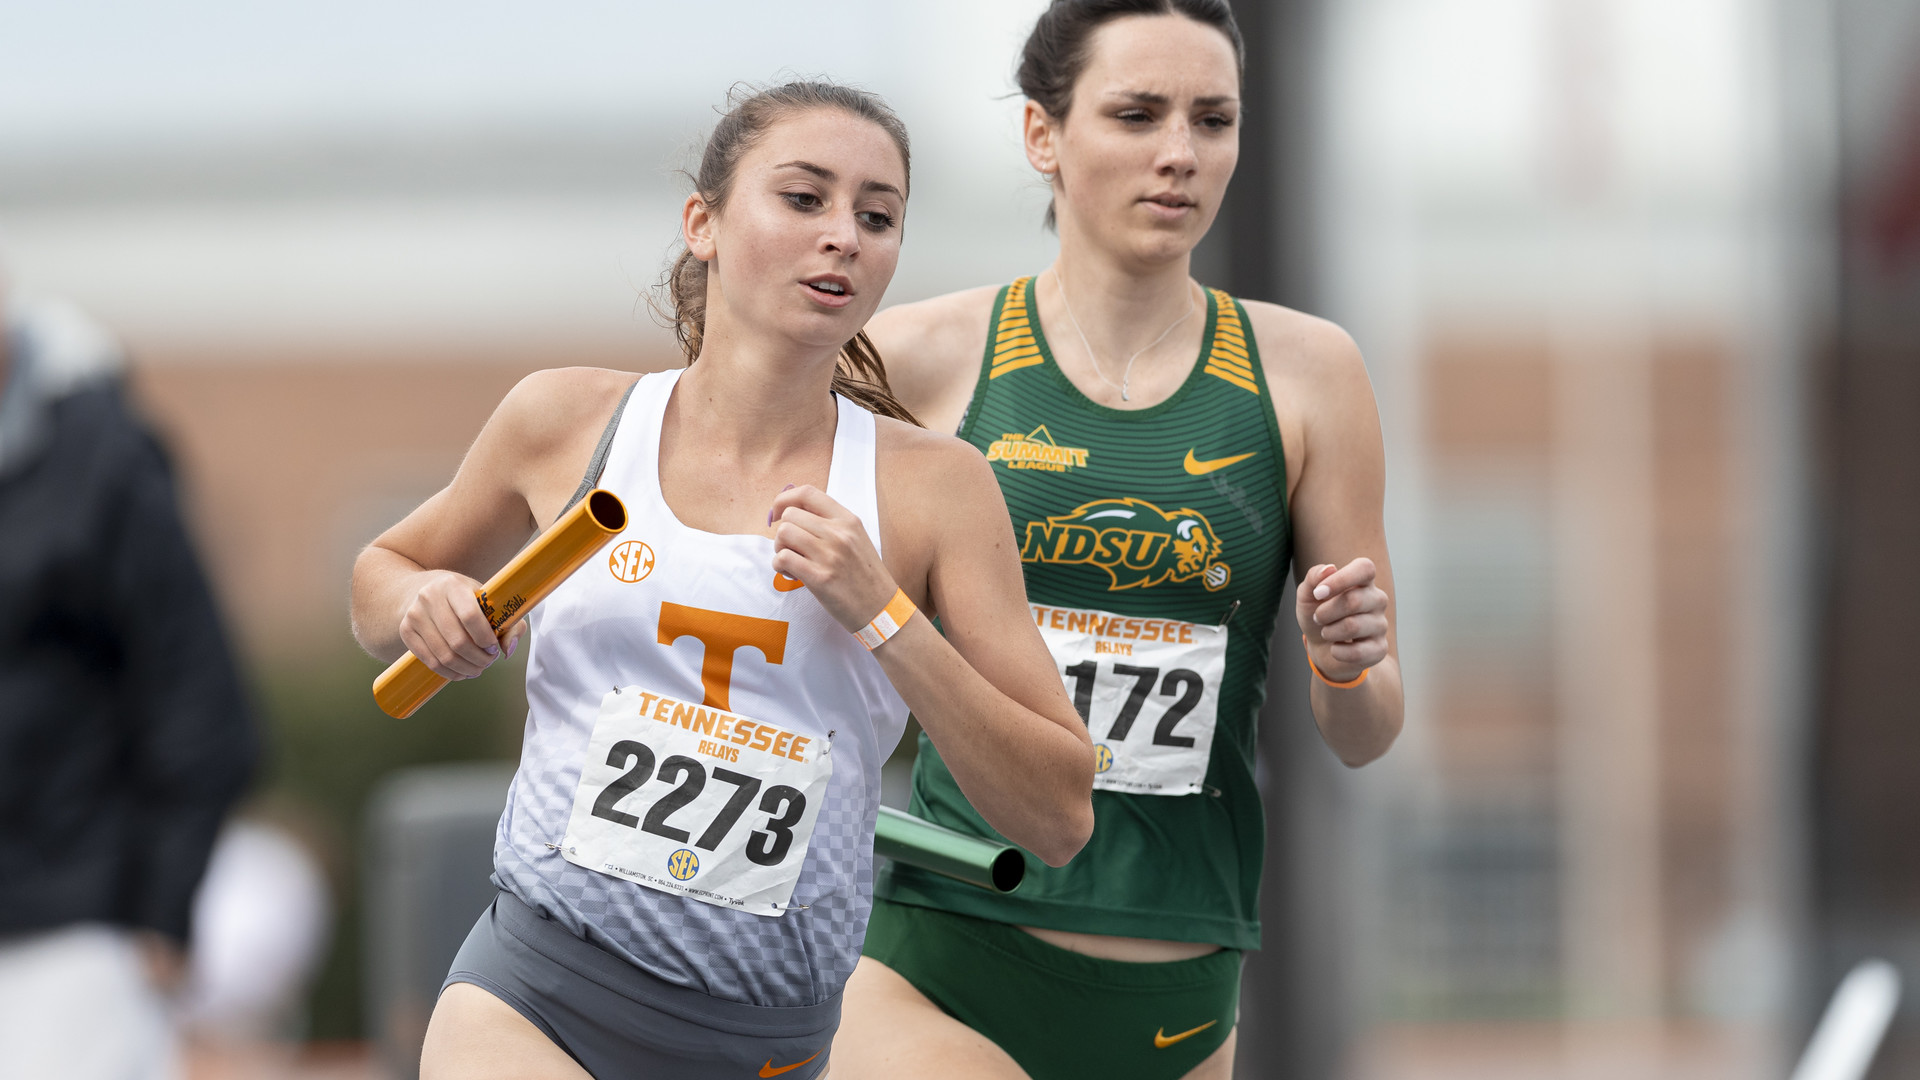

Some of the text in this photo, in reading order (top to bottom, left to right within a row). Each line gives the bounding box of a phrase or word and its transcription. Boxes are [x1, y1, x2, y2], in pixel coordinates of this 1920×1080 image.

[986, 440, 1090, 468] SUMMIT
[1002, 433, 1025, 441] THE
[1007, 461, 1066, 473] LEAGUE
[610, 542, 655, 582] SEC
[1021, 521, 1172, 571] NDSU
[1032, 605, 1196, 645] TENNESSEE
[657, 601, 790, 713] T
[1095, 641, 1133, 657] RELAYS
[1065, 659, 1205, 749] 172
[638, 691, 812, 763] TENNESSEE
[697, 739, 740, 763] RELAYS
[1095, 743, 1114, 774] EC
[591, 739, 807, 867] 2273
[668, 849, 699, 881] SEC
